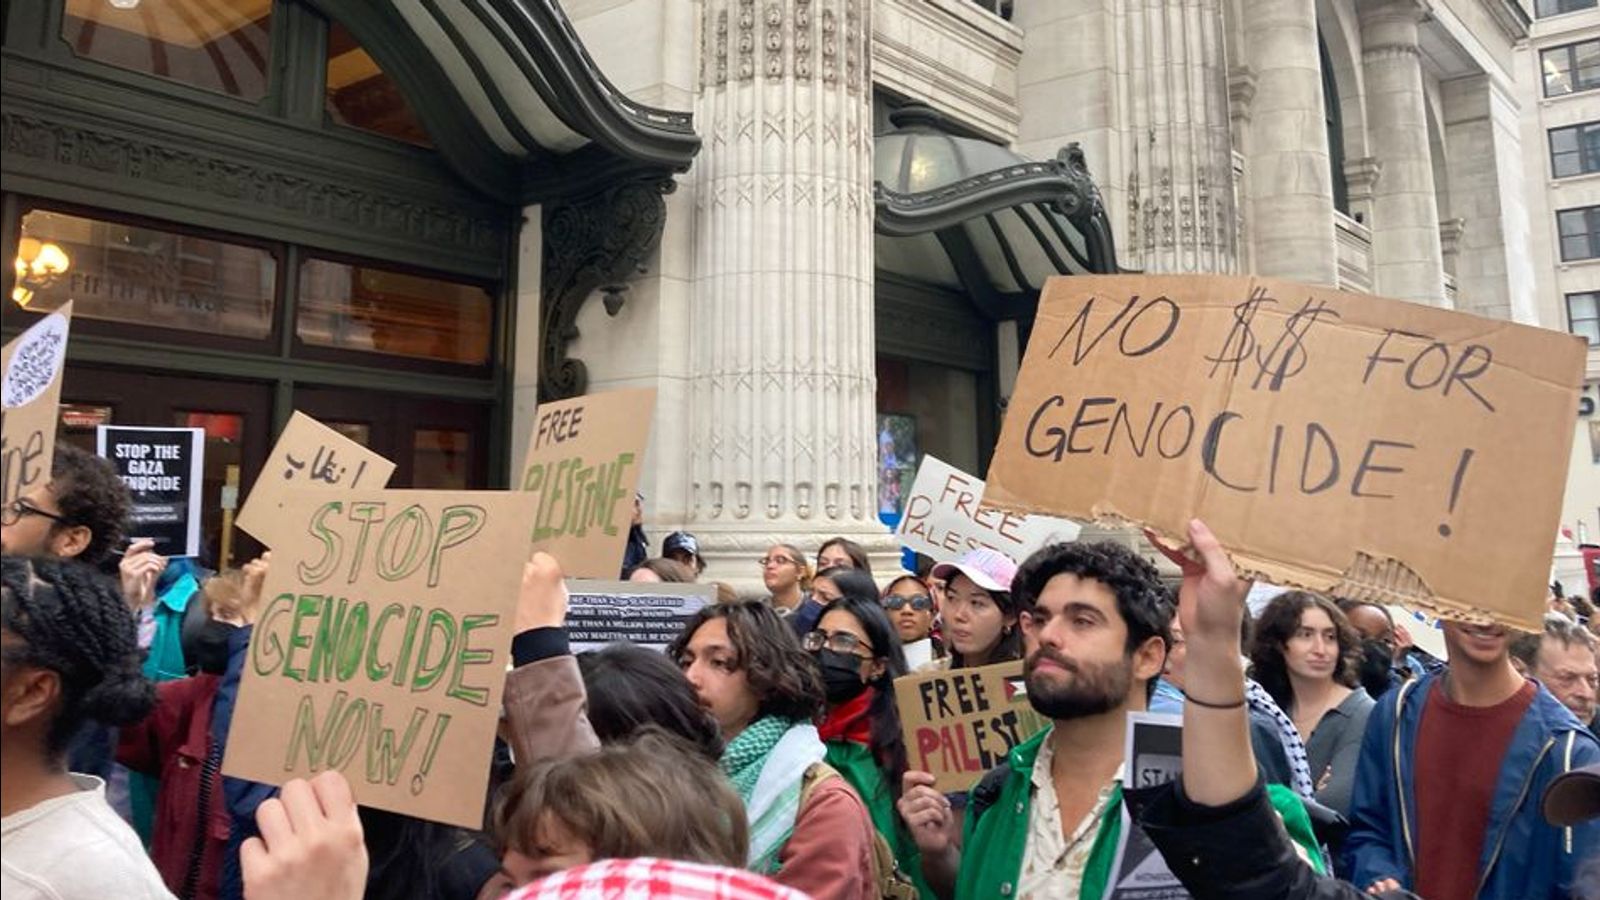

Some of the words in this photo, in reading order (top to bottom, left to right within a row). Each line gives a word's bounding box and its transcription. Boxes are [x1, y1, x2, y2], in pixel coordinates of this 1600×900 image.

[70, 273, 136, 299] FIFTH
[1048, 295, 1180, 366] NO
[1362, 328, 1495, 412] FOR
[115, 443, 151, 459] STOP
[154, 444, 181, 459] THE
[535, 406, 585, 451] FREE
[128, 460, 164, 475] GAZA
[939, 474, 1026, 545] FREE
[297, 501, 487, 588] STOP
[253, 592, 499, 707] GENOCIDE
[918, 674, 990, 721] FREE
[283, 690, 452, 796] NOW!
